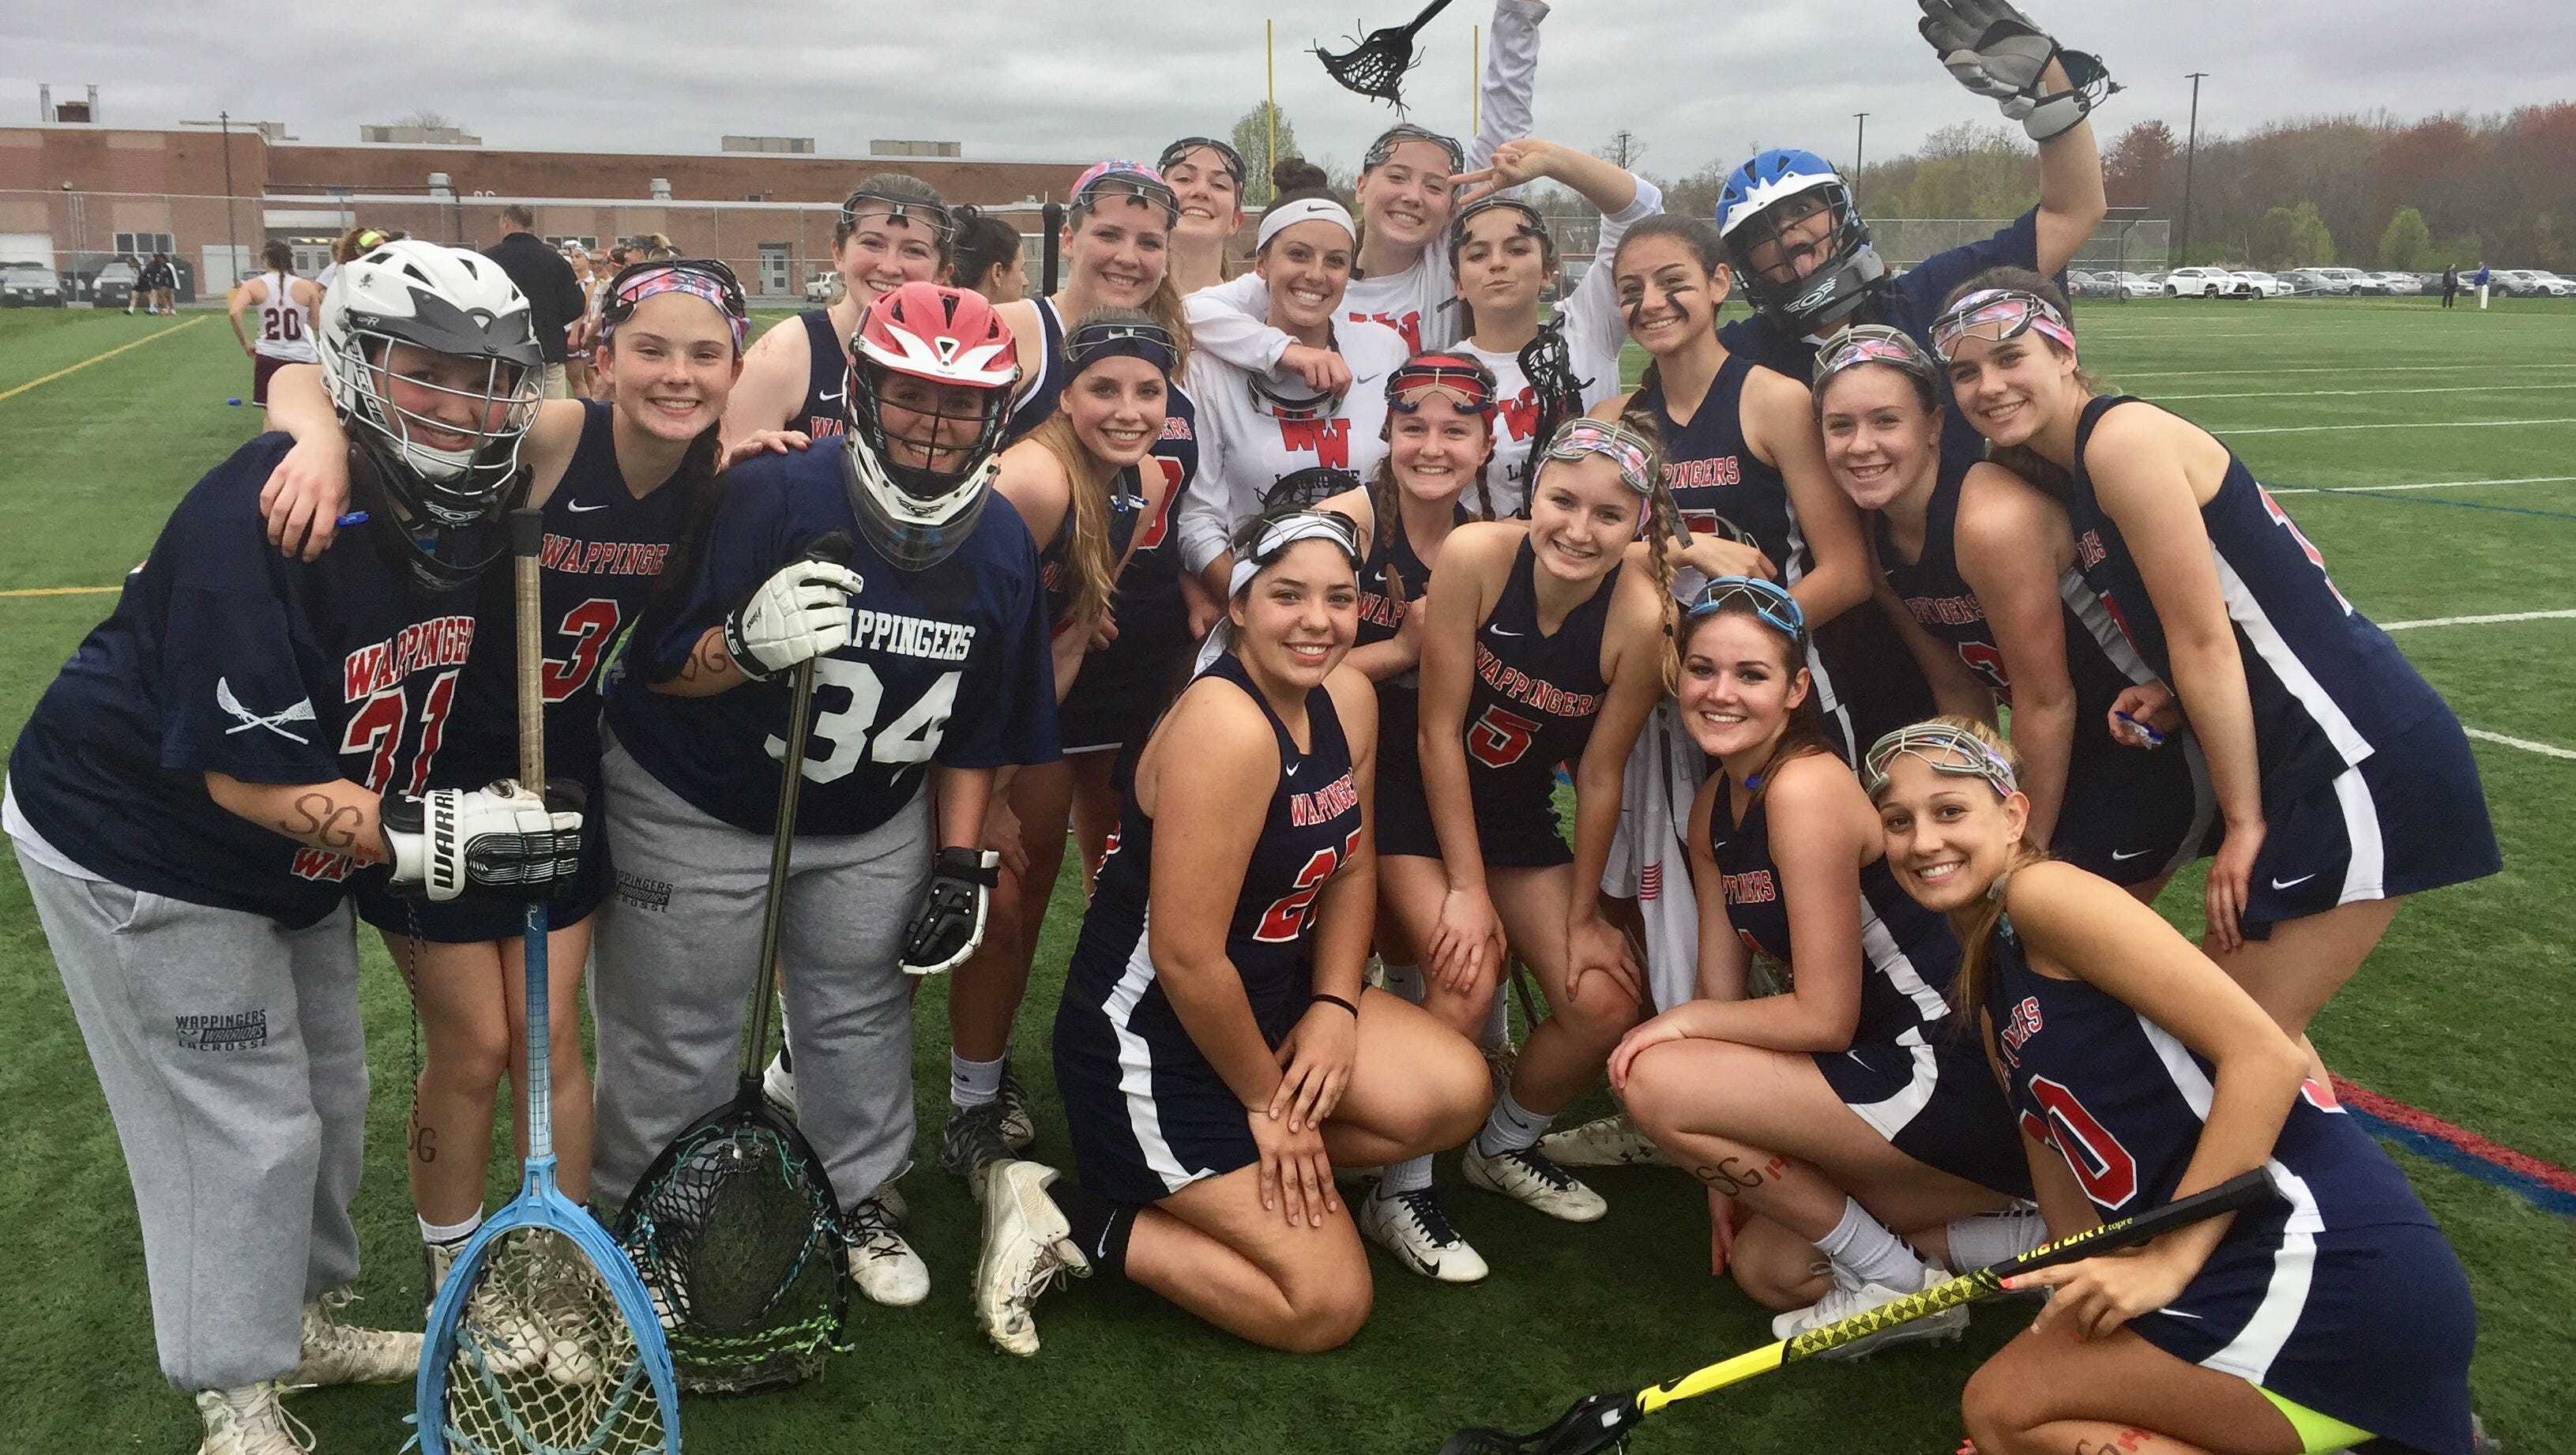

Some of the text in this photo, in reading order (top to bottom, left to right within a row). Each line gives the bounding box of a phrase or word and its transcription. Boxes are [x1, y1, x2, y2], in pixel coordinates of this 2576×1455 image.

[264, 307, 302, 340] 20
[542, 597, 621, 703] 3
[763, 656, 963, 788] 34
[1466, 703, 1543, 769] 5
[279, 792, 364, 848] SG
[434, 788, 455, 890] WARRI
[175, 1008, 266, 1028] WAPPINGERS
[179, 1039, 268, 1051] LACROSSE
[203, 1024, 263, 1042] WARRIORS
